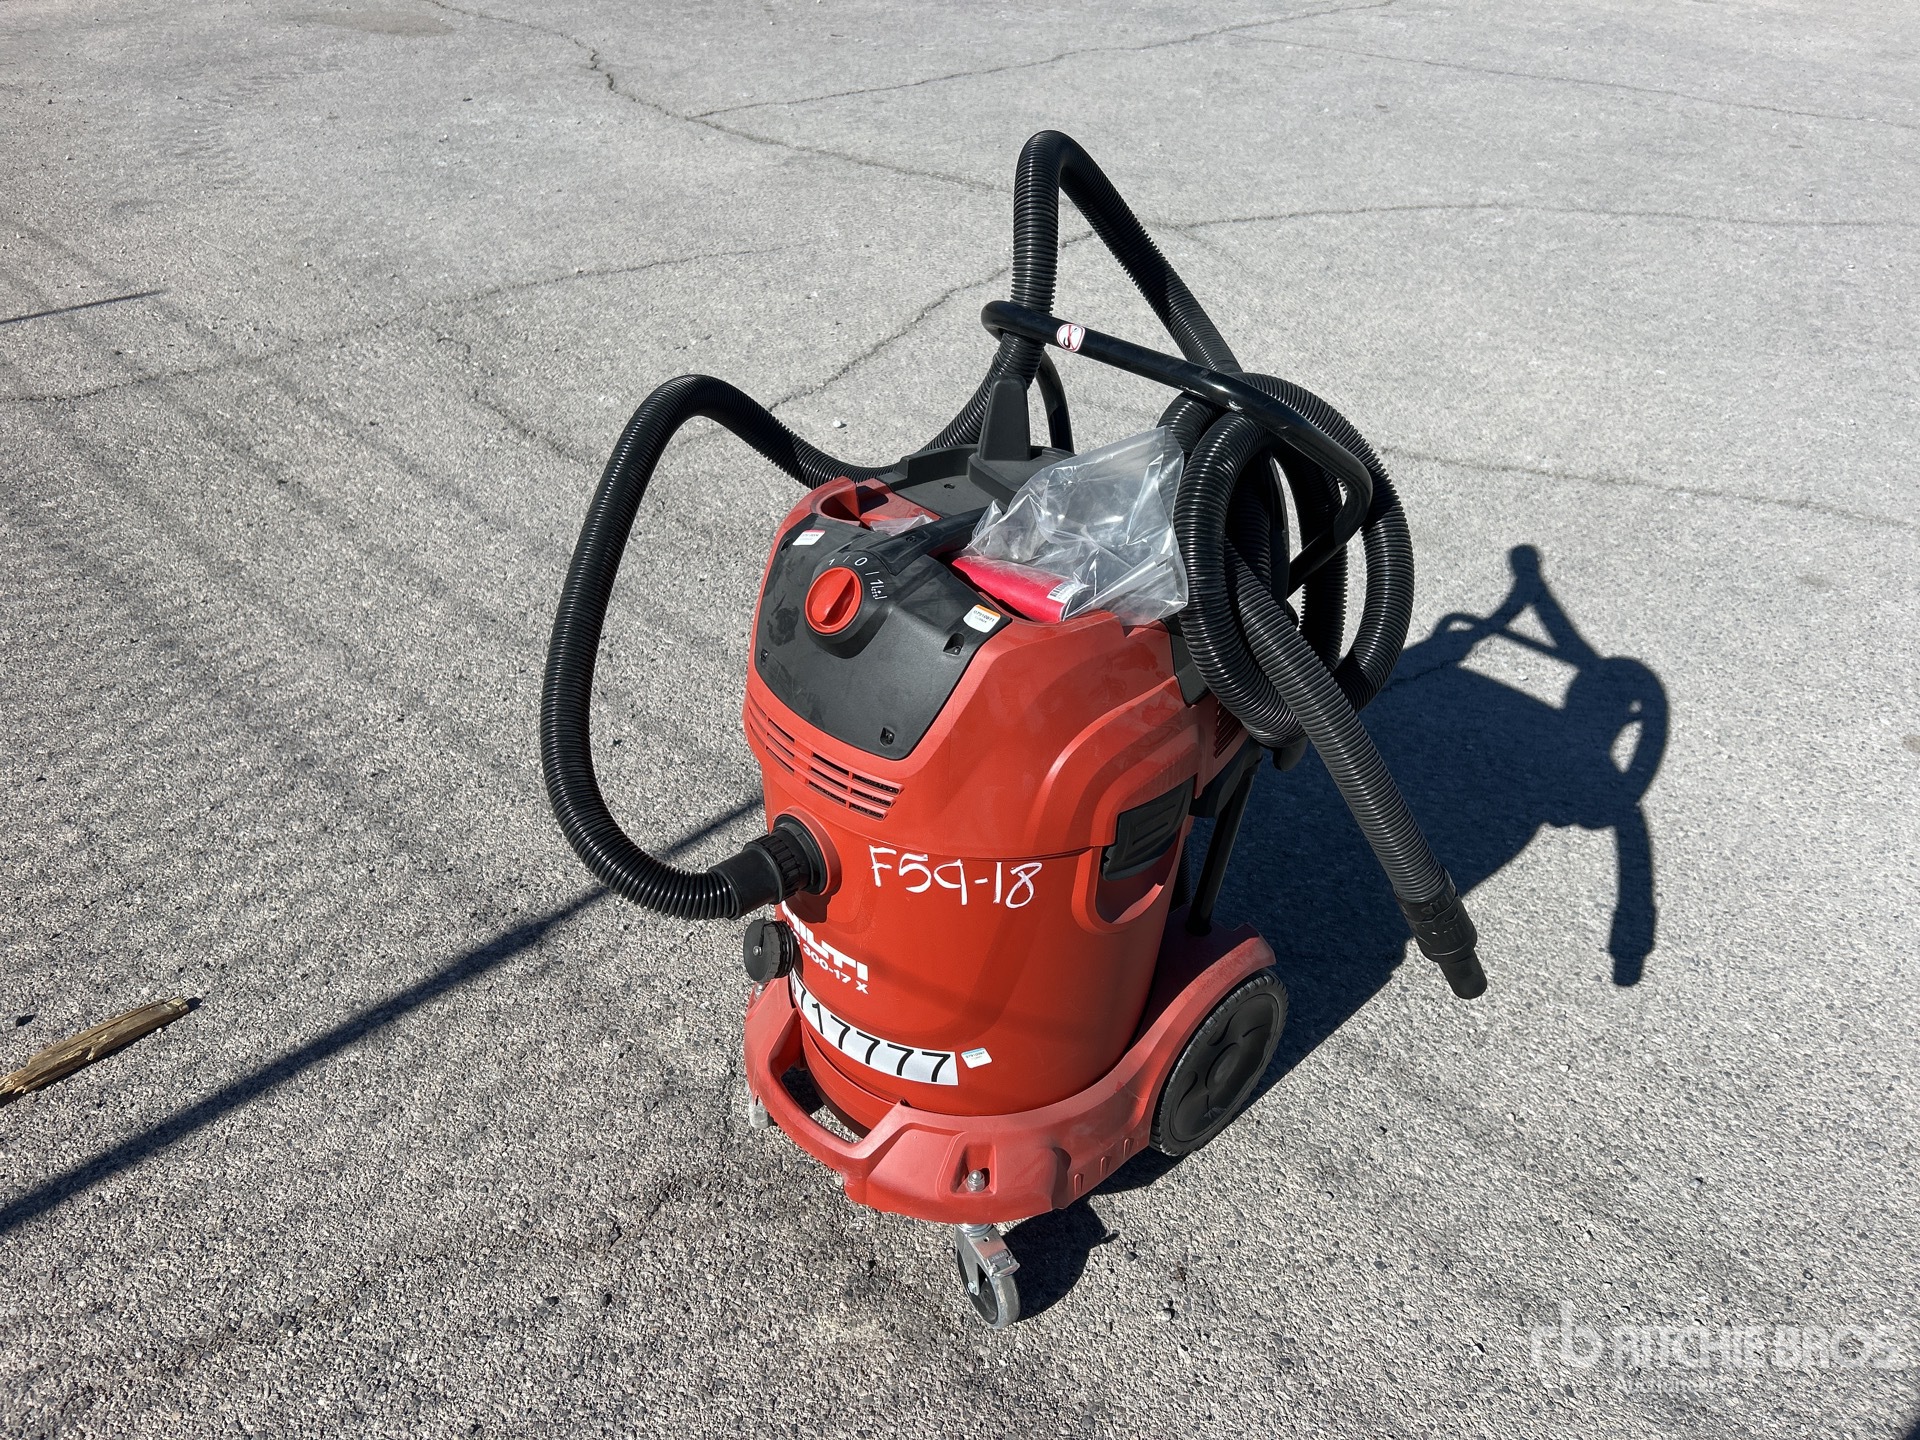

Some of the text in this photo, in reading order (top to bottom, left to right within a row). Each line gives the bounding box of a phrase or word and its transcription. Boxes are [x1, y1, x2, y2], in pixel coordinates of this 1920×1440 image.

[854, 557, 868, 566] 0
[868, 845, 1043, 909] F59-18
[855, 980, 869, 994] X
